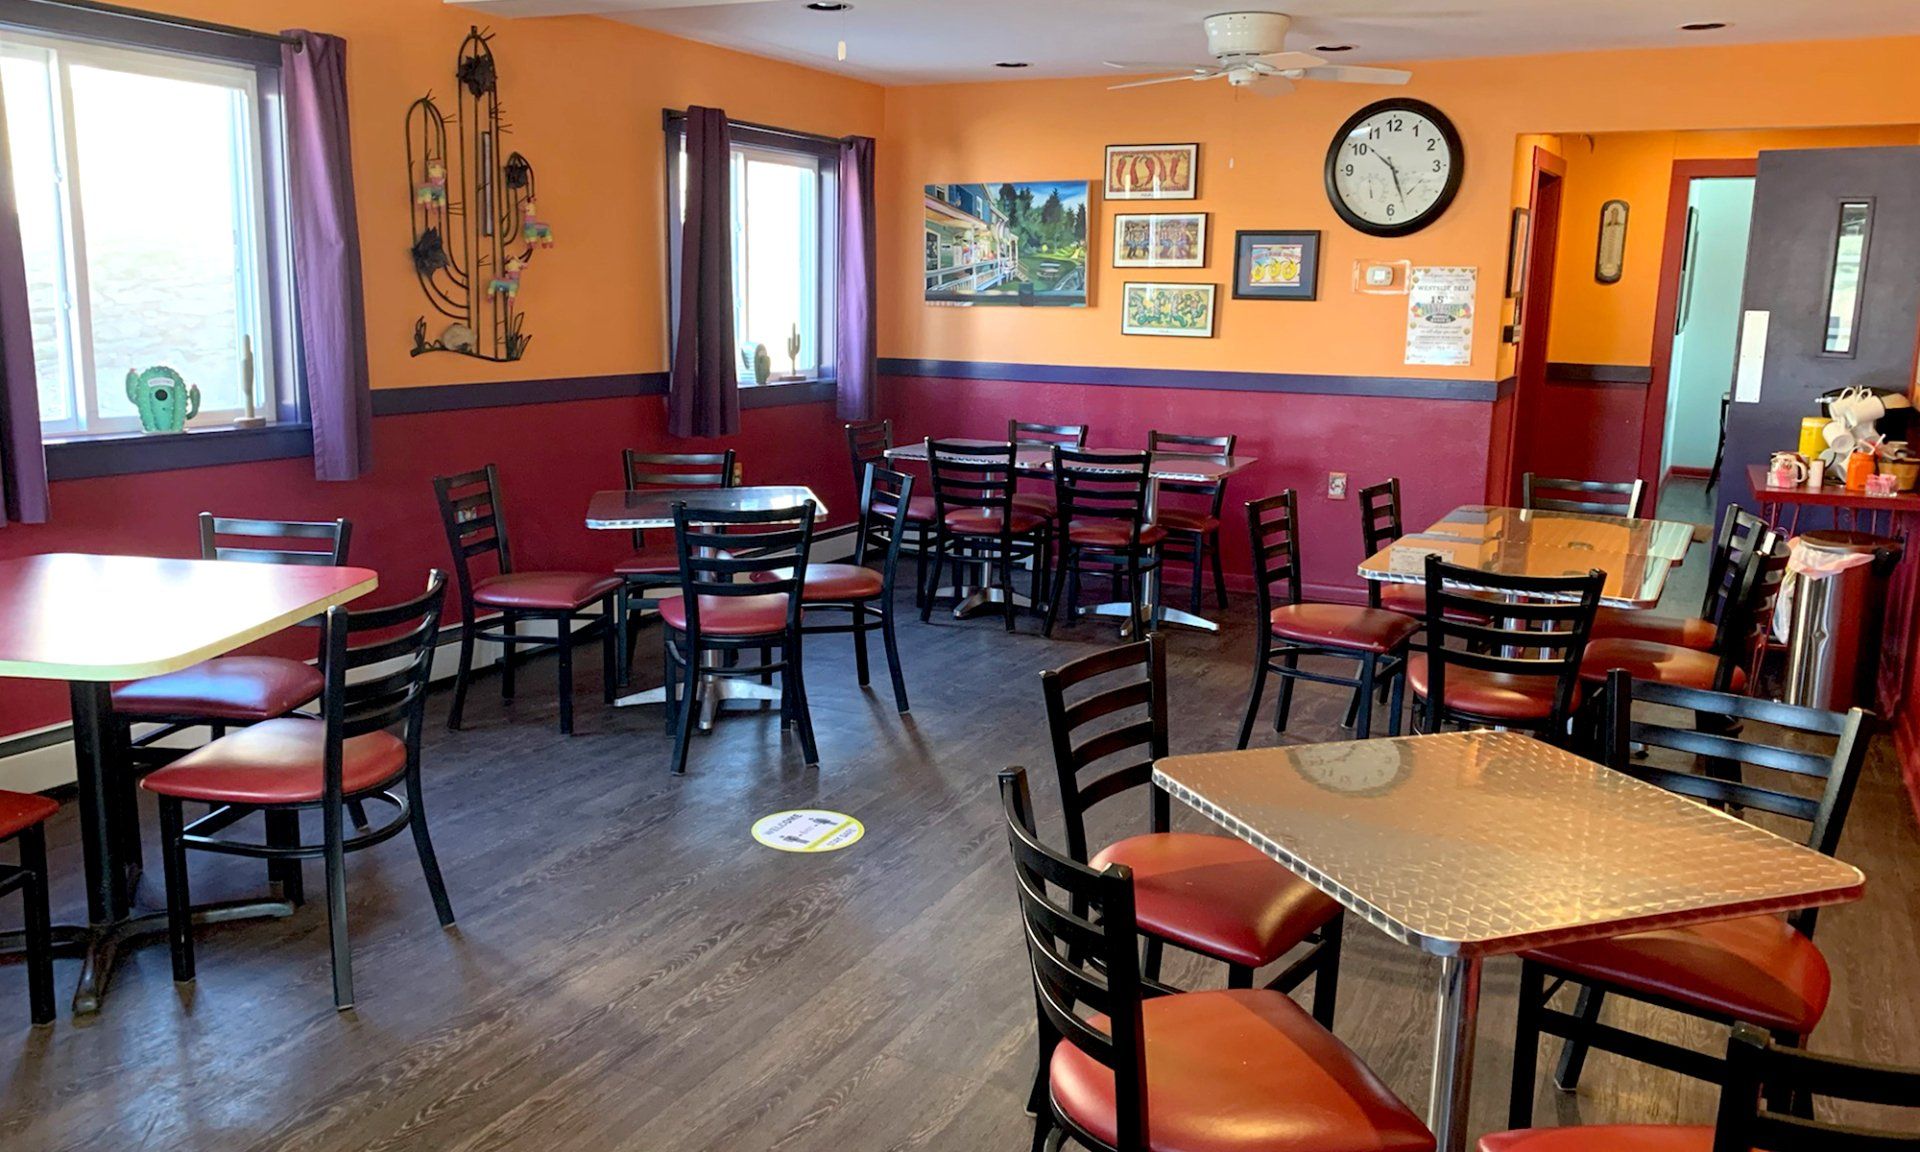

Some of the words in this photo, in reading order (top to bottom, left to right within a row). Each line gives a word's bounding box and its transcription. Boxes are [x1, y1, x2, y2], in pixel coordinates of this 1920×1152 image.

[1386, 119, 1403, 132] 12
[1412, 124, 1419, 137] 1
[1368, 127, 1381, 140] 11
[1351, 143, 1367, 156] 10
[1427, 138, 1436, 151] 2
[1345, 164, 1354, 176] 9
[1432, 160, 1441, 173] 3
[1386, 204, 1395, 216] 6
[764, 813, 803, 835] WELCOME
